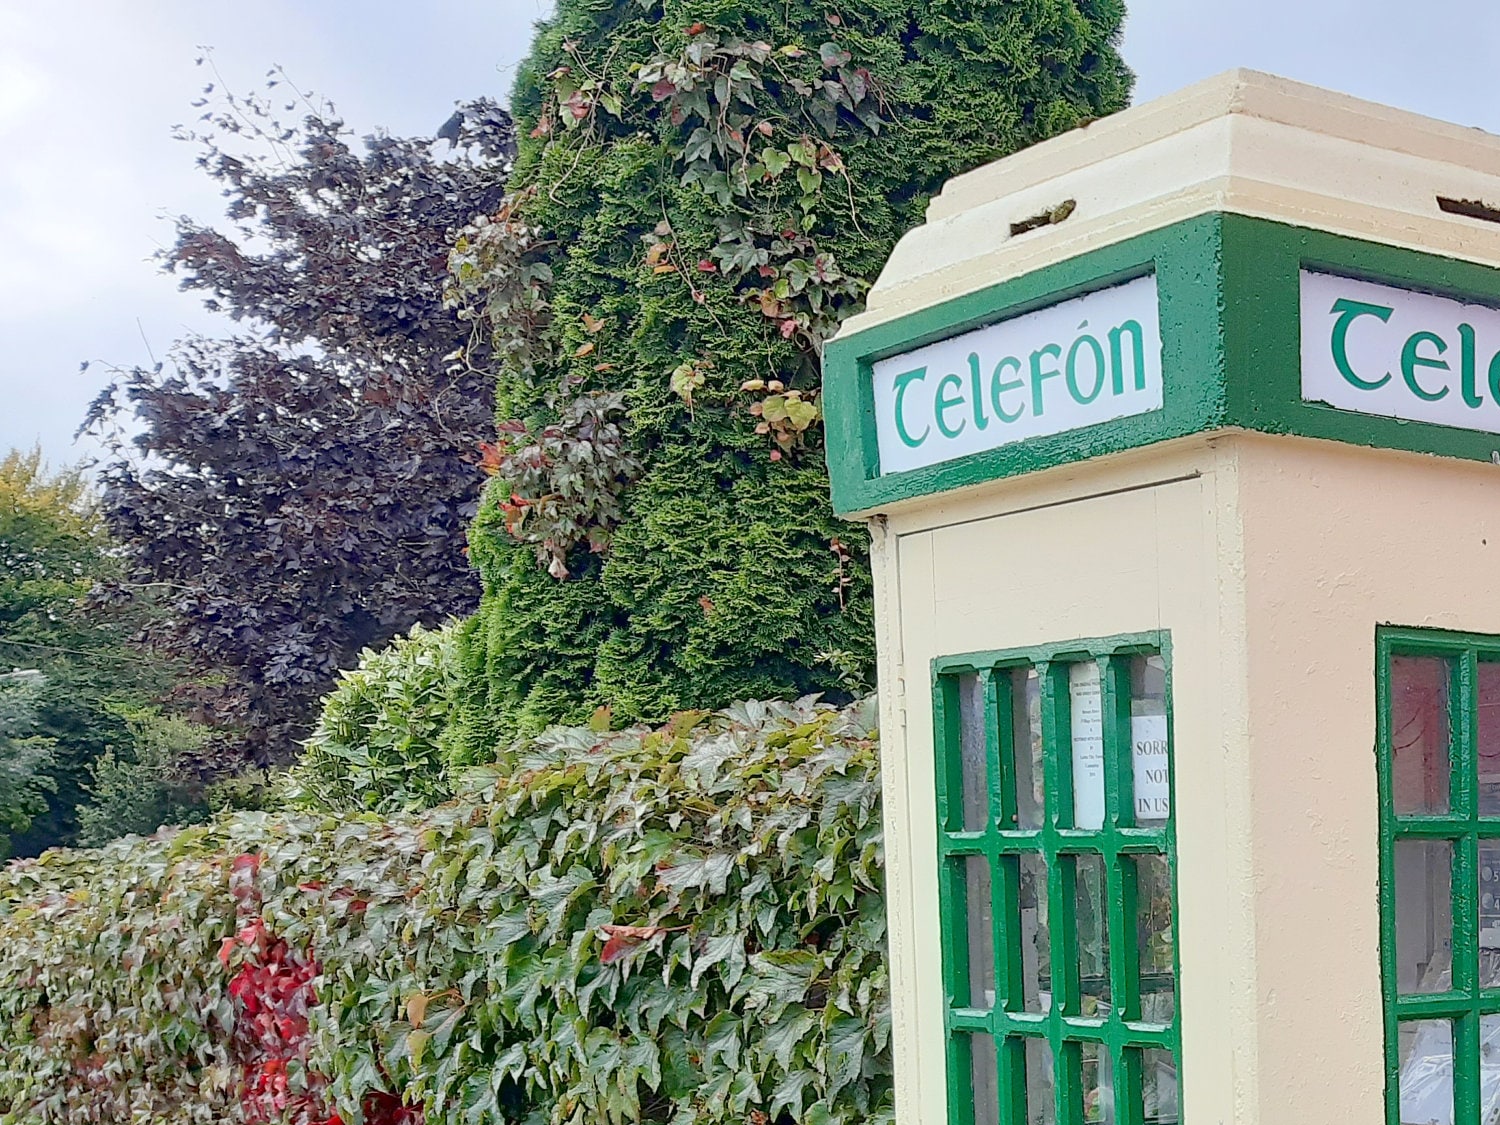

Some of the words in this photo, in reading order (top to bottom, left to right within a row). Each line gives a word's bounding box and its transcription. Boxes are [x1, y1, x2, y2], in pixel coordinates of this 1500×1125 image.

[1136, 741, 1168, 756] SORR
[1138, 798, 1151, 813] IN
[1154, 797, 1169, 813] US
